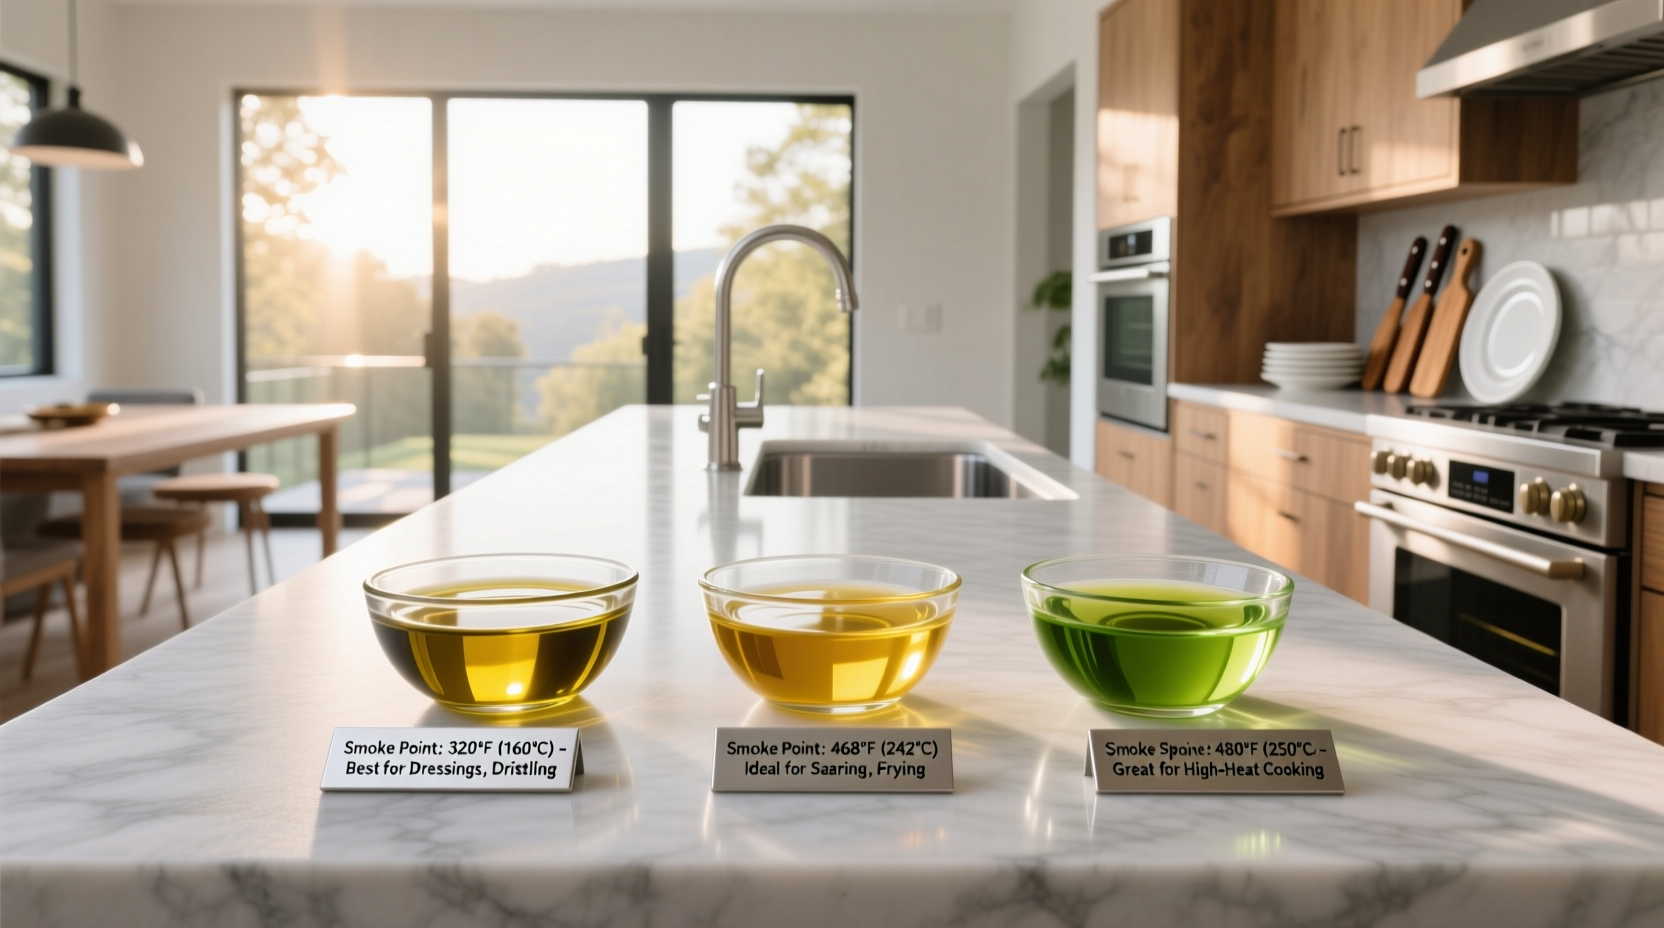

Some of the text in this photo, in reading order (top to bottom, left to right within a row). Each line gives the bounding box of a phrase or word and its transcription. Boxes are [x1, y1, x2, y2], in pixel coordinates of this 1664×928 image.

[344, 740, 395, 755] Smoke
[399, 740, 443, 755] Point:
[727, 741, 778, 756] Smoke
[782, 741, 826, 756] Point:
[1105, 741, 1156, 756] Smoke
[345, 761, 379, 776] Best
[383, 760, 406, 776] for
[409, 760, 488, 779] Dressings,
[745, 761, 780, 776] Ideal
[785, 760, 807, 776] for
[877, 761, 926, 780] Frying
[1112, 761, 1325, 780] Great for High-Heat Cooking
